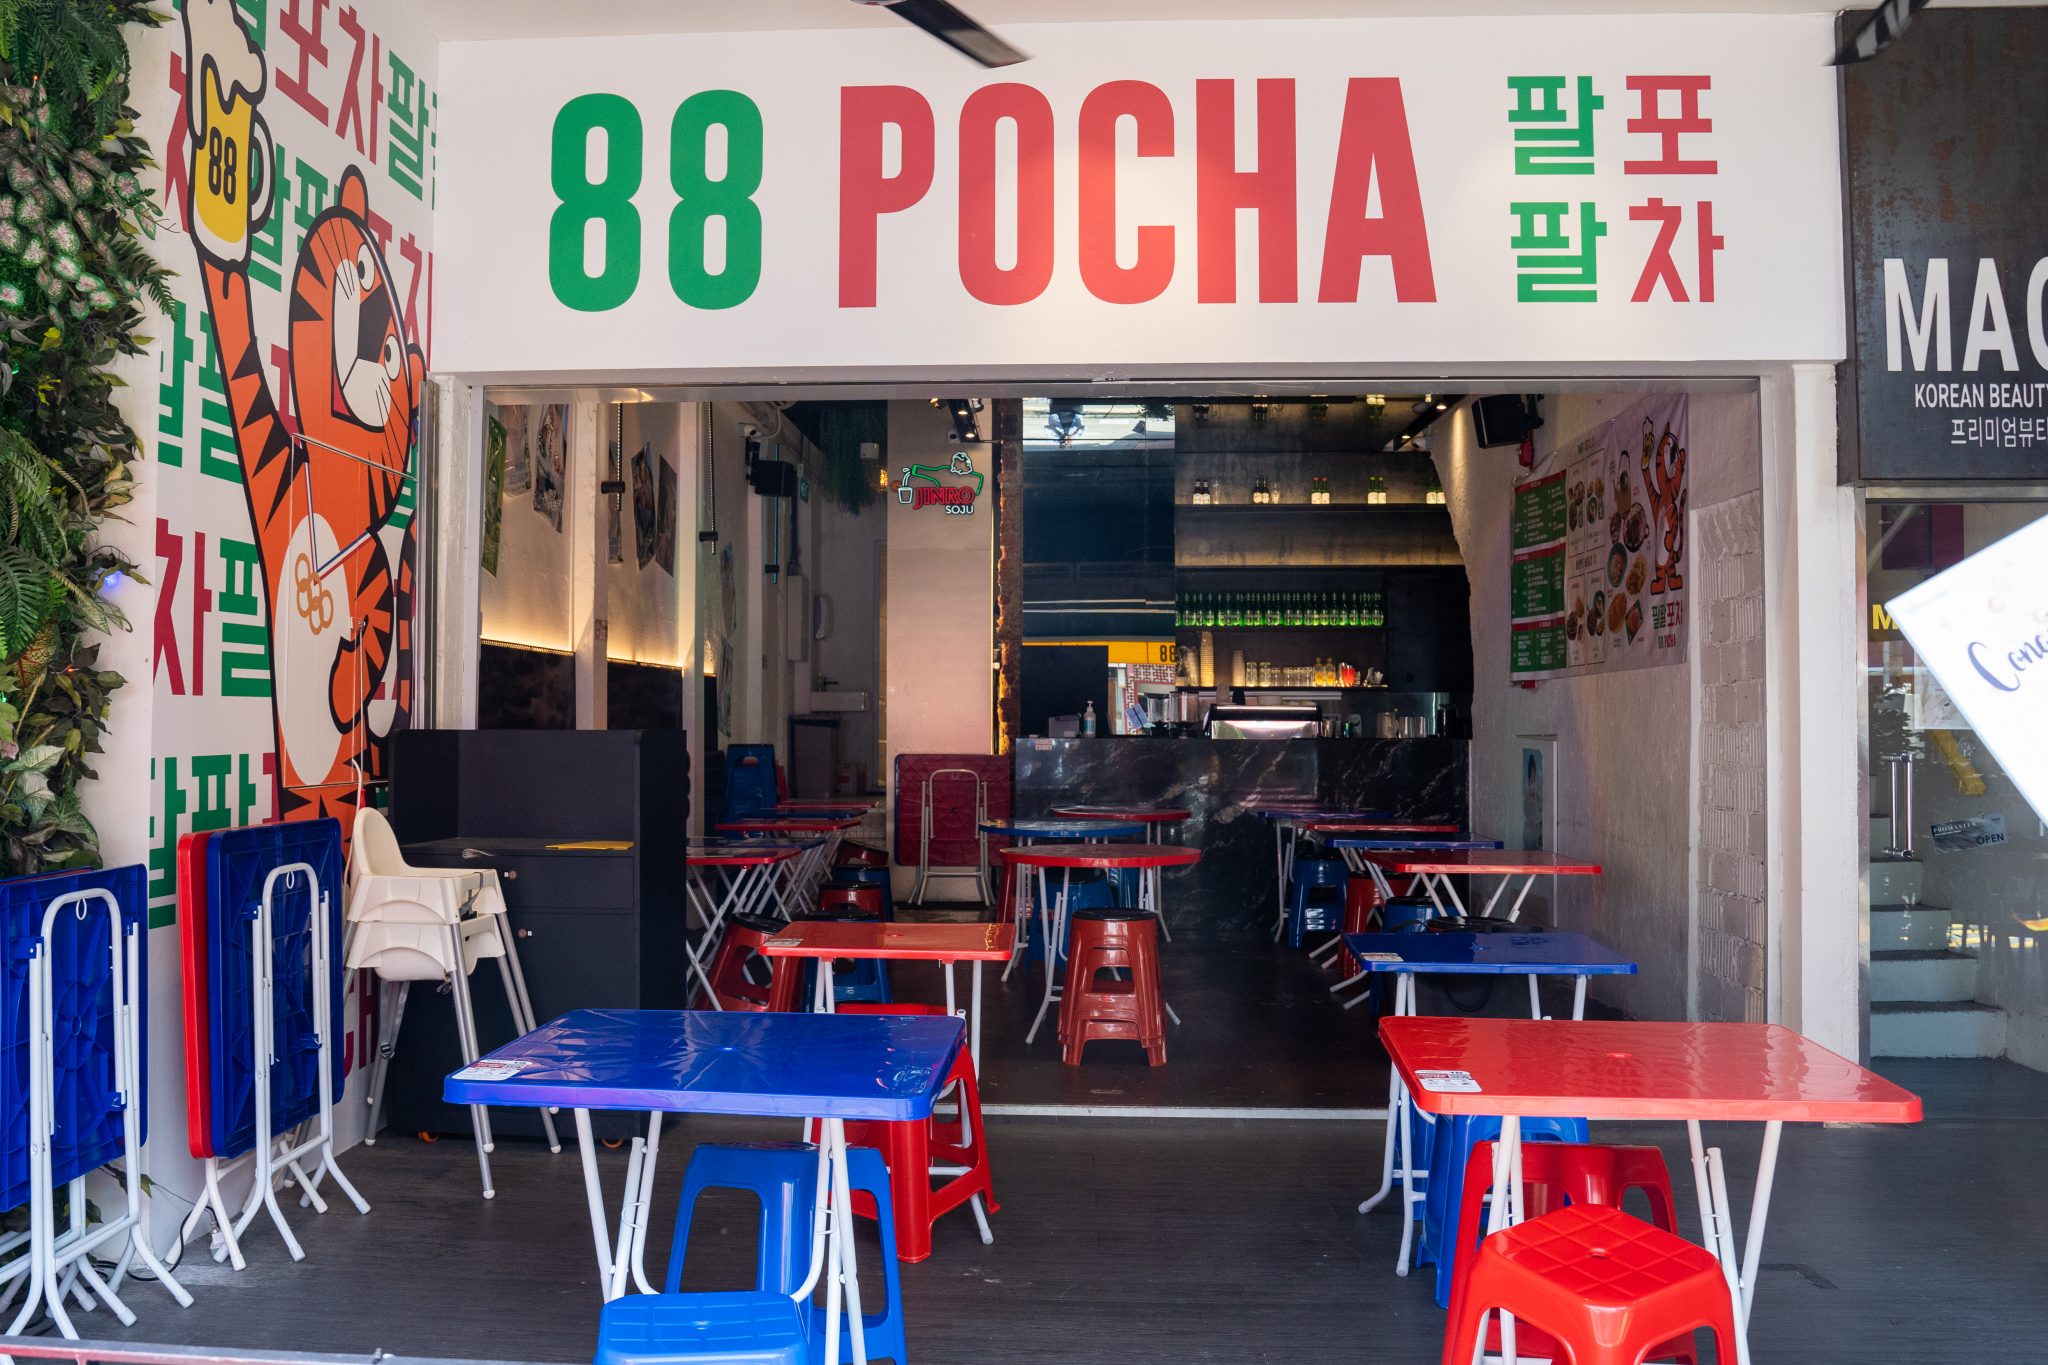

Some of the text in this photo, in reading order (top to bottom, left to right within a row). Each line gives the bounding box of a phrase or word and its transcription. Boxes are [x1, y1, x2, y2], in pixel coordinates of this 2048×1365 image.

[208, 126, 238, 205] 88
[549, 77, 1438, 312] 88 POCHA
[1914, 384, 2048, 408] KOREAN BEAUT
[913, 486, 976, 511] JINRO
[945, 504, 975, 515] SOJU
[1160, 644, 1176, 662] 88
[1975, 832, 2005, 845] OPEN
